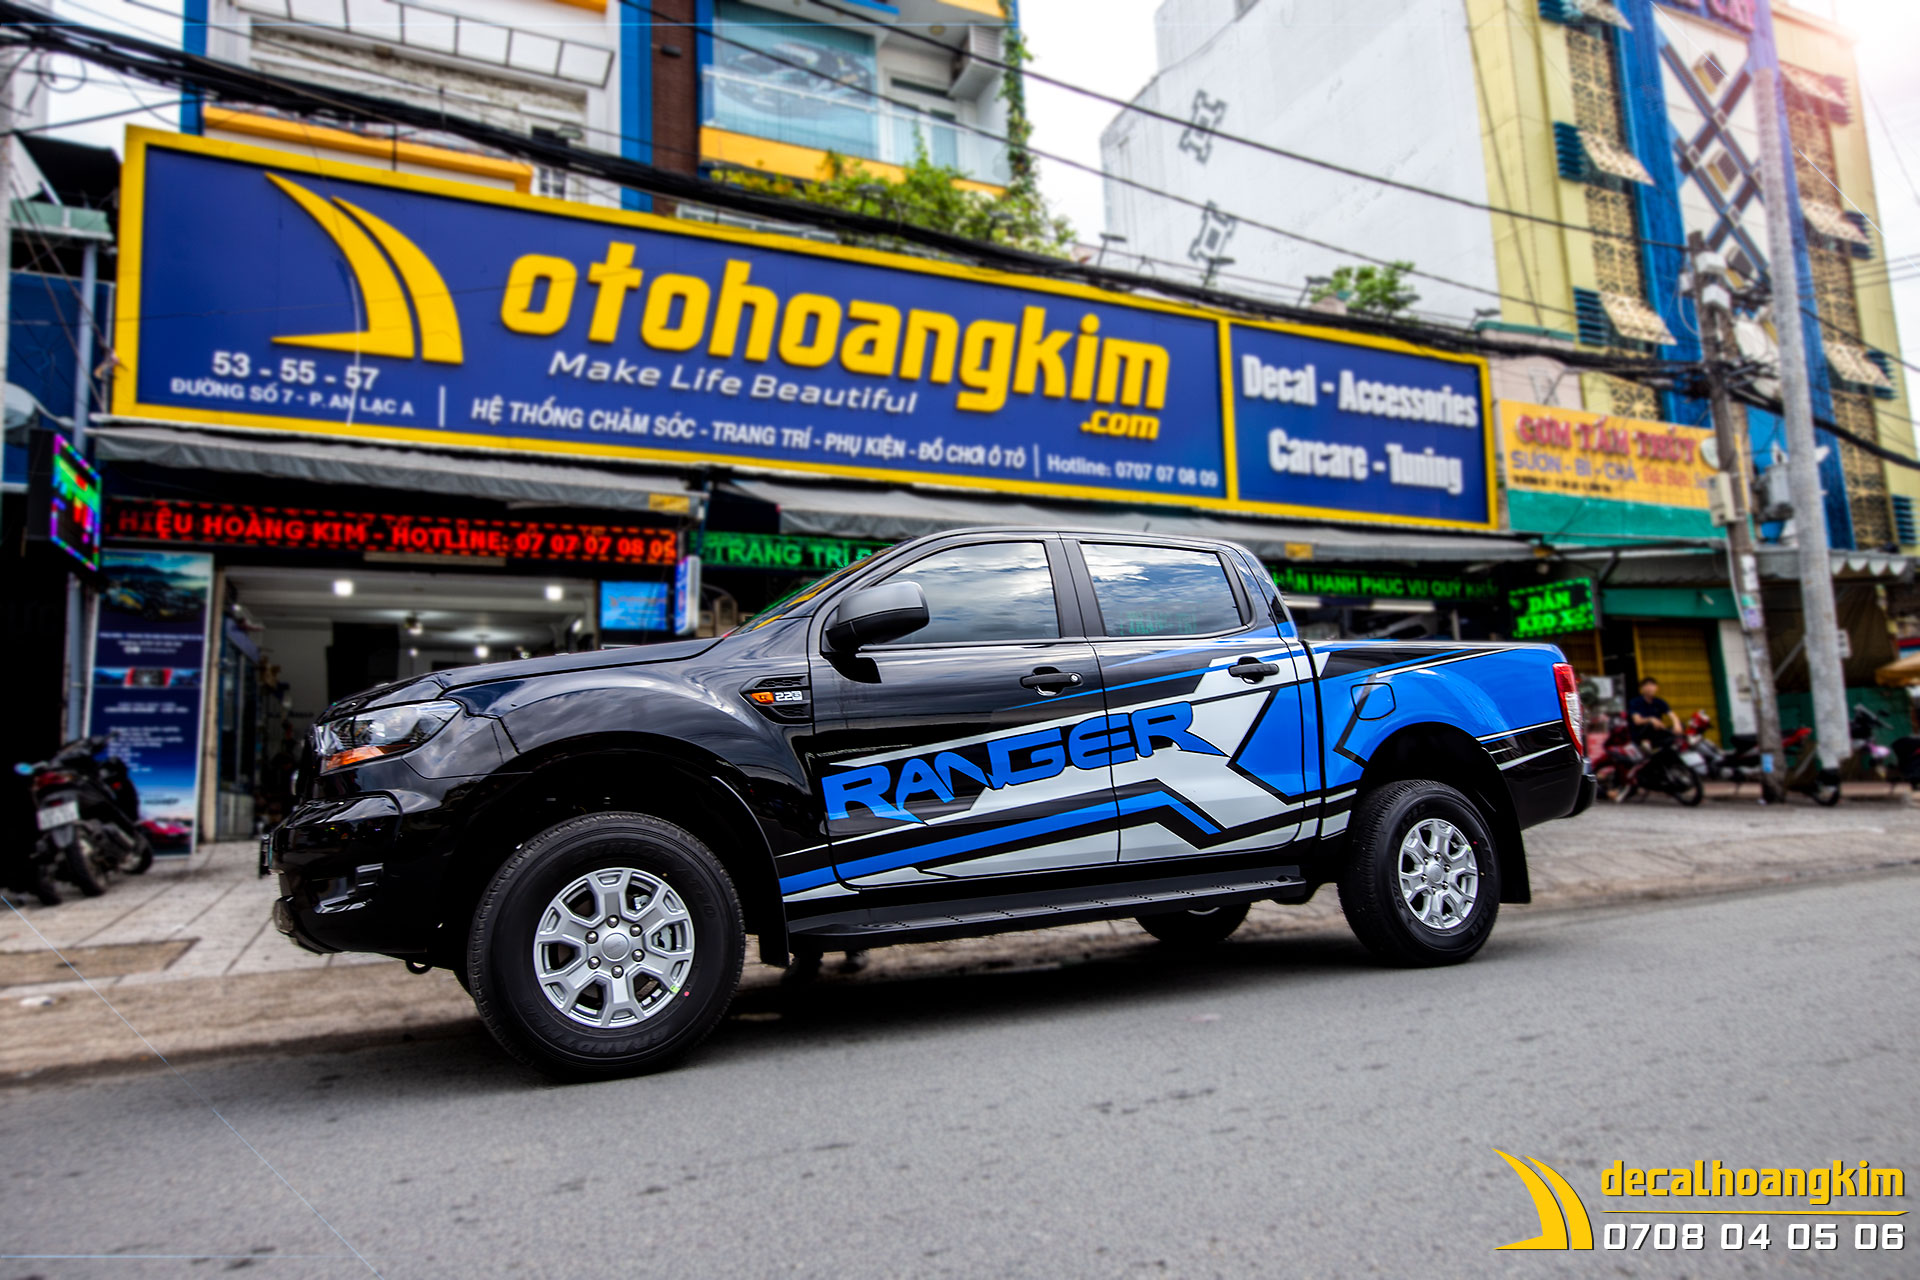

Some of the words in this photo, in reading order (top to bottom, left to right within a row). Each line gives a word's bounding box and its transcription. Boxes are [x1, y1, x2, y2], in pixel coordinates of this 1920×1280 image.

[501, 241, 1169, 412] otohoangkim
[170, 377, 244, 399] ĐƯỜNG
[250, 381, 279, 403] SỐ
[281, 389, 293, 403] 7
[360, 397, 397, 416] LẠC
[400, 401, 415, 416] A
[213, 351, 250, 377] 53
[280, 358, 315, 384] 55
[345, 365, 379, 391] 57
[549, 351, 662, 387] Make
[670, 364, 743, 396] Life
[750, 374, 918, 414] Beautiful
[1242, 354, 1317, 406] Decal
[1338, 370, 1478, 427] Accessories
[470, 395, 504, 425] HỆ
[509, 395, 583, 429] THỐNG
[589, 407, 649, 434] CHĂM
[653, 412, 696, 438] SÓC
[712, 421, 776, 446] TRANG
[781, 426, 813, 449] TRÍ
[825, 433, 861, 459] PHỤ
[865, 433, 906, 461] KIỆN
[1080, 410, 1160, 440] .com
[1047, 454, 1112, 478] Hotline:
[1115, 461, 1152, 480] 0707
[1156, 464, 1175, 483] 07
[1178, 467, 1197, 486] 08
[1200, 470, 1218, 488] 09
[1268, 428, 1368, 481] Carcare
[1385, 443, 1463, 494] Tuning
[203, 512, 304, 540] HOÀNG
[313, 521, 366, 543] KIM
[392, 525, 509, 550] HOTLINE:
[515, 533, 545, 552] 07
[550, 535, 579, 553] 07
[585, 537, 612, 555] 07
[617, 538, 643, 556] 08
[713, 540, 802, 566] TRANG
[822, 701, 1230, 823] RANGER
